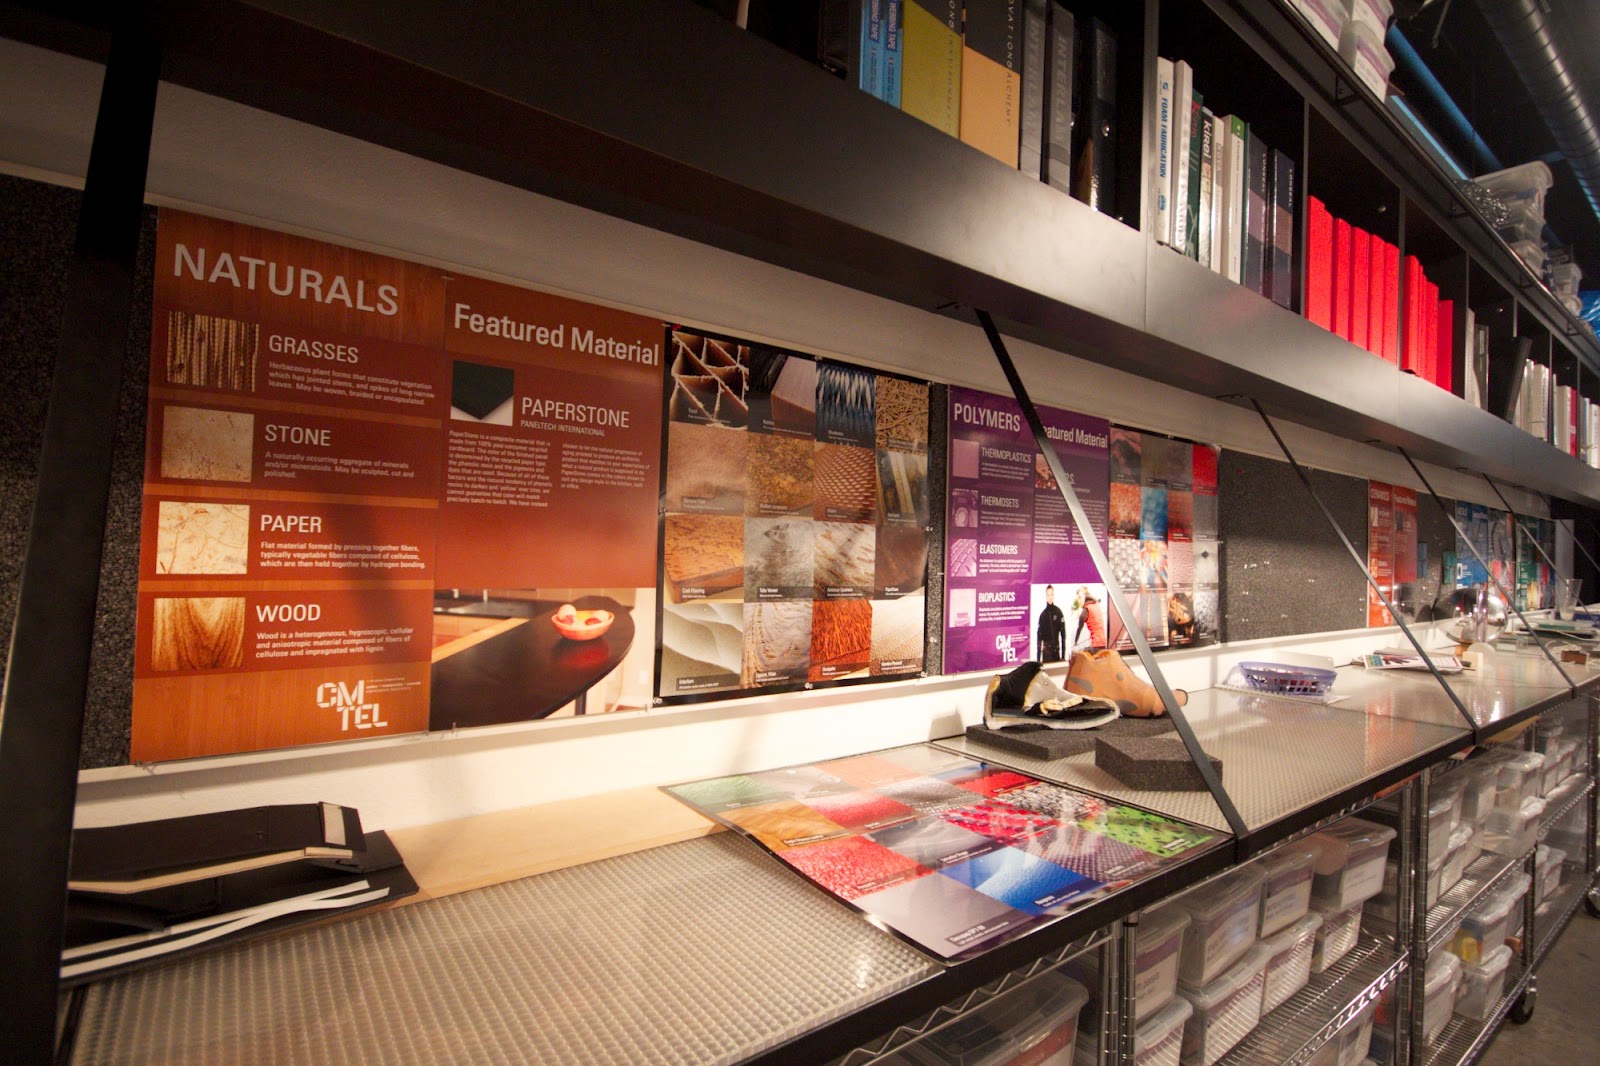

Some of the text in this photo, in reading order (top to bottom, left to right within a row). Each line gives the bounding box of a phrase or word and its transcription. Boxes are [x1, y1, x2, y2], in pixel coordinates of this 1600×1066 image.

[888, 34, 896, 50] TAPE
[174, 244, 398, 316] NATURALS
[454, 302, 658, 366] Featured Material
[268, 334, 359, 364] GRASSES
[522, 396, 630, 428] PAPERSTONE
[954, 403, 1020, 432] POLYMERS
[264, 424, 331, 446] STONE
[520, 420, 605, 437] PANELTECH INTERNATIONAL
[1043, 426, 1108, 448] atured Material
[982, 447, 1031, 464] THERMOPLASTICS
[981, 496, 1020, 508] THERMOSETS
[260, 514, 322, 532] PAPER
[260, 551, 291, 560] typically
[293, 551, 327, 560] vegetable
[348, 552, 381, 561] composed
[390, 552, 420, 560] cellulose,
[334, 543, 342, 552] by
[343, 543, 371, 552] pressing
[372, 544, 400, 552] together
[401, 544, 419, 552] fibers,
[980, 544, 1018, 555] ELASTOMERS
[332, 560, 360, 569] together
[361, 560, 369, 569] by
[370, 560, 399, 569] hydrogen
[400, 560, 426, 569] bonding.
[978, 592, 1016, 603] BIOPLASTICS
[256, 604, 320, 622] WOOD
[271, 640, 311, 649] anisotropic
[312, 638, 341, 646] material
[342, 636, 376, 646] composed
[294, 631, 347, 639] heterogeneous,
[305, 646, 348, 657] impregnated
[1002, 648, 1018, 662] TEL
[336, 703, 388, 731] TEL
